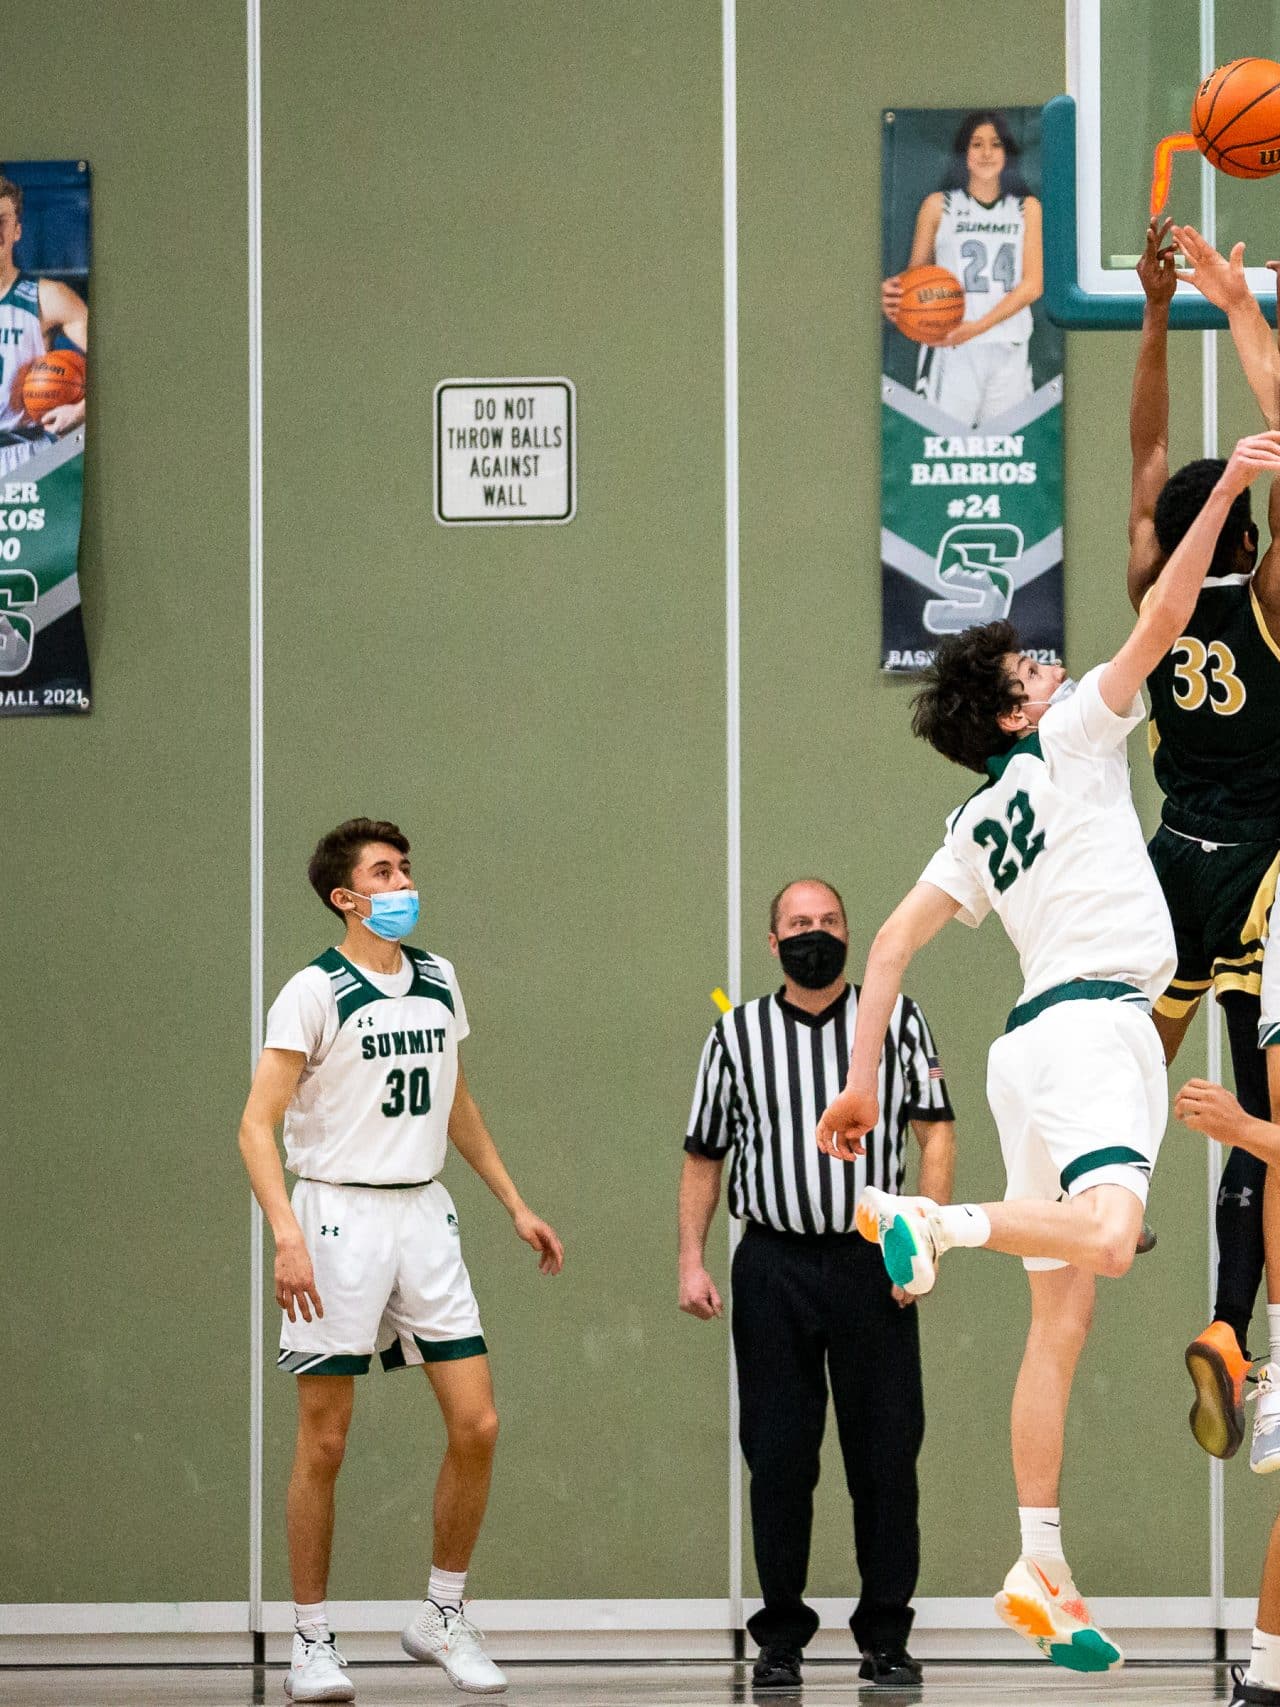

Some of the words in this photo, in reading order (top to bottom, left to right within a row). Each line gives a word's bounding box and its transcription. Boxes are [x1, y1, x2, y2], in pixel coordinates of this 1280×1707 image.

[955, 223, 1020, 235] SUMMIT
[960, 239, 1016, 293] 24
[475, 398, 496, 420] DO
[504, 397, 534, 419] NOT
[448, 427, 503, 449] THROW
[511, 426, 562, 448] BALLS
[923, 436, 1024, 458] KAREN
[470, 455, 540, 478] AGAINST
[911, 462, 1037, 485] BARRIOS
[0, 482, 40, 504] ER
[483, 484, 527, 506] WALL
[947, 494, 1000, 518] #24
[1170, 636, 1246, 715] 33
[43, 689, 82, 705] 2021
[973, 789, 1046, 895] 22
[361, 1028, 446, 1060] SUMMIT
[381, 1067, 431, 1118] 30
